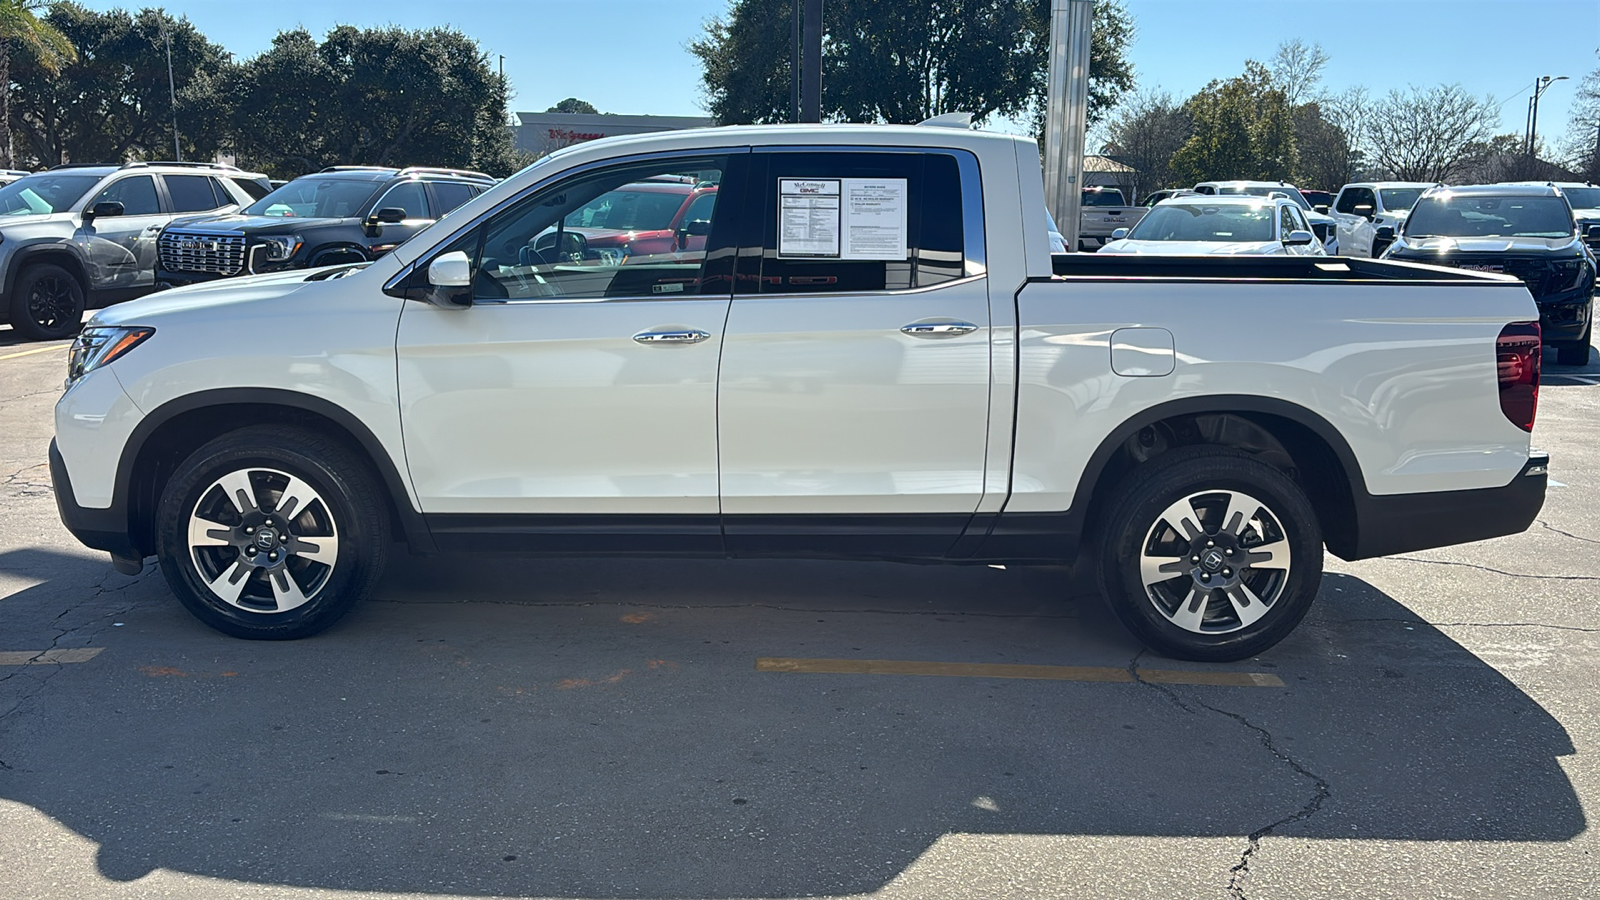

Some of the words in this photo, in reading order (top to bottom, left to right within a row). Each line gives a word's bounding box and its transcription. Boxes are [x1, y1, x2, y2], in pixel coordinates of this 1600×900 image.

[548, 129, 604, 142] Walgreens
[181, 240, 217, 251] GMC
[1459, 264, 1504, 273] GMC
